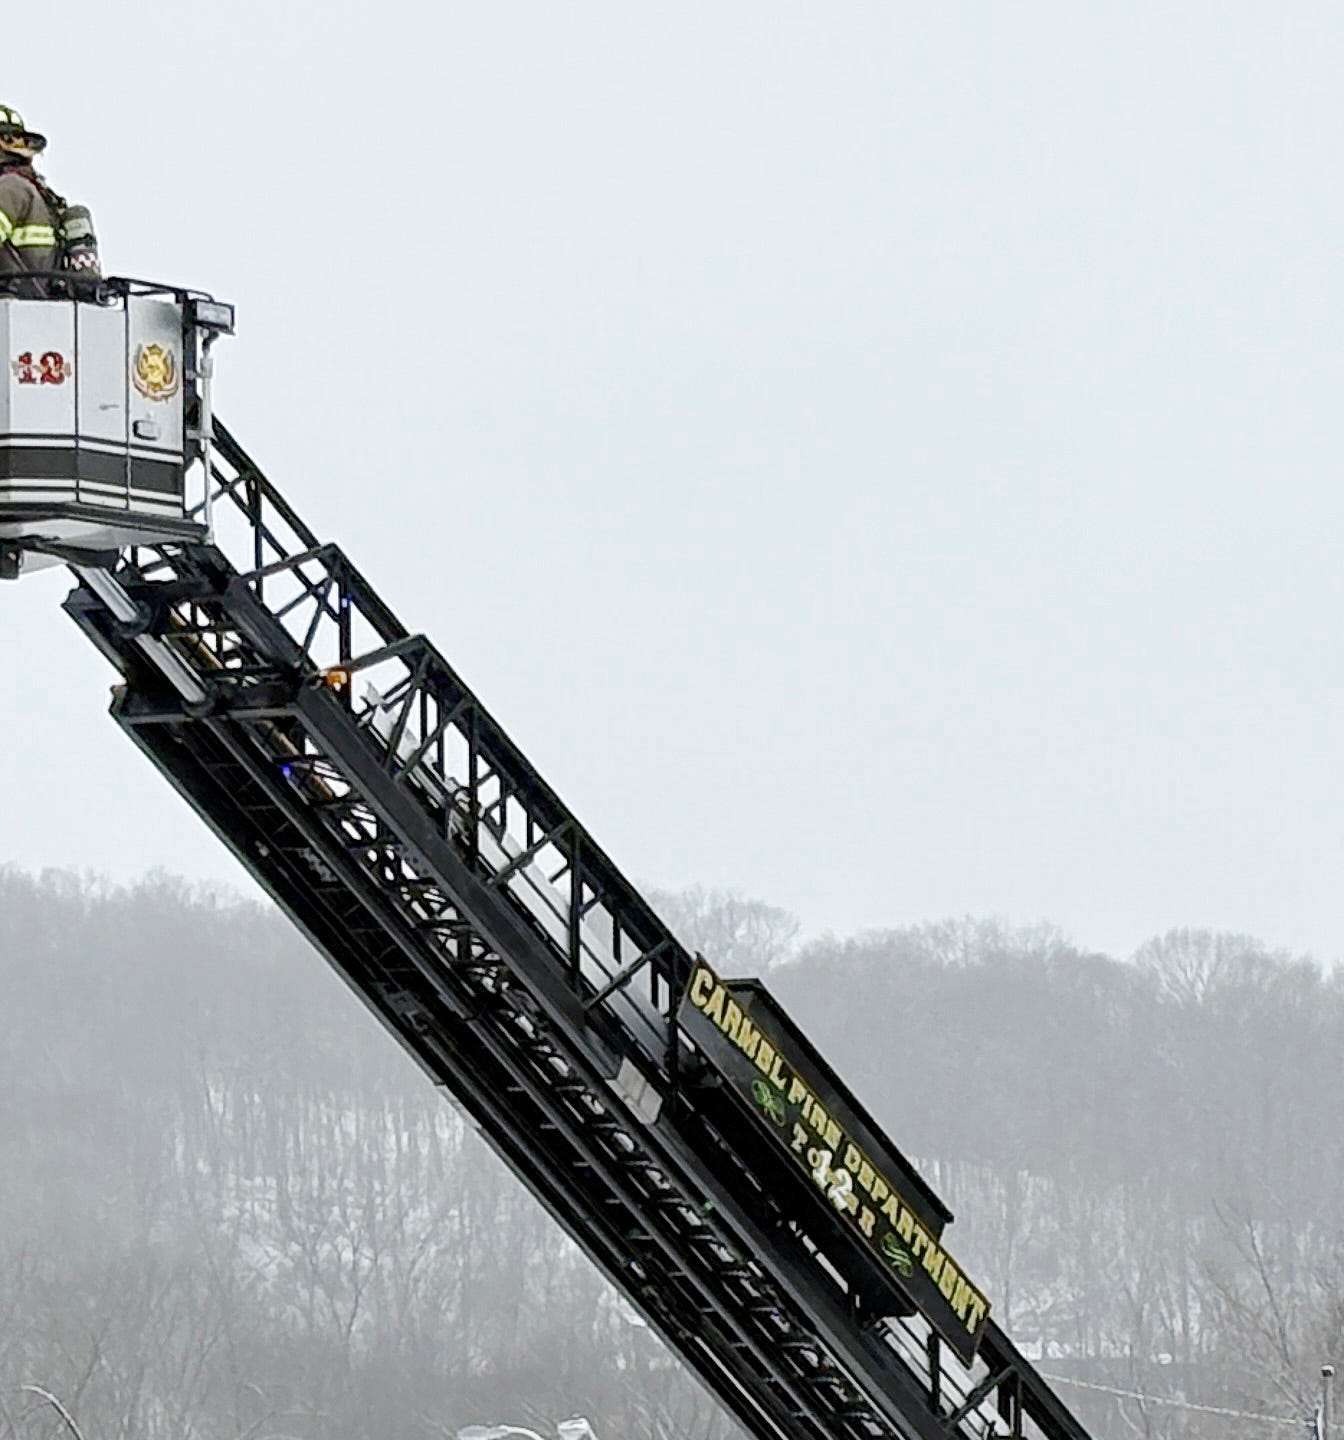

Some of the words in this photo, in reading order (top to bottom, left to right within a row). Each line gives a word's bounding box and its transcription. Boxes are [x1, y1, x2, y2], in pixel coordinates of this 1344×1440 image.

[17, 351, 66, 386] 12
[689, 967, 789, 1092] CARMEL
[843, 1141, 990, 1336] DEPARTMENT
